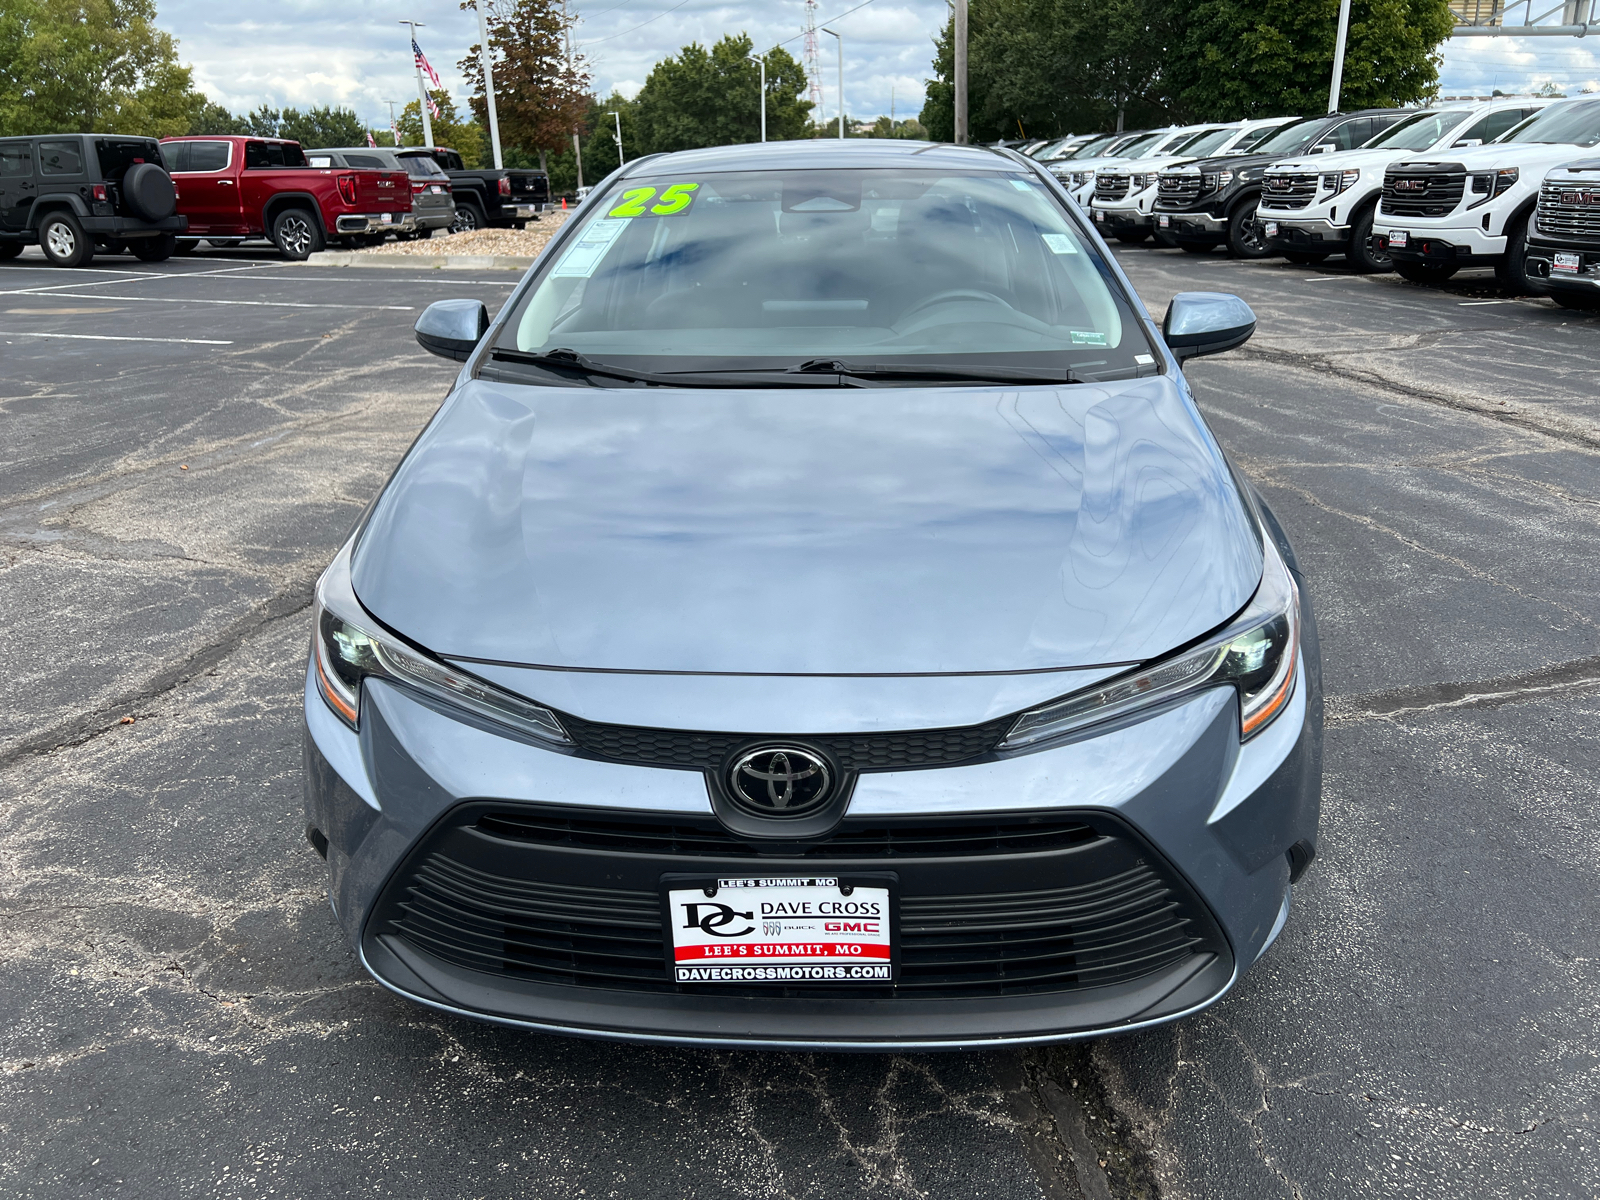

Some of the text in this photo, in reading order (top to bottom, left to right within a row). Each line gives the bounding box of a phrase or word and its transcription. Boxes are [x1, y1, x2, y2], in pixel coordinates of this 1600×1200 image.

[1394, 180, 1425, 190] GMC
[608, 183, 699, 218] 25
[1562, 192, 1600, 204] GMC
[720, 880, 755, 888] LEE'S
[758, 879, 810, 887] SUMMIT
[760, 902, 881, 915] DAVE CROSS
[680, 902, 756, 938] DC
[824, 922, 880, 933] GMC
[704, 944, 862, 957] LEE'S SUMMIT, MO
[678, 966, 889, 980] DAVECROSSMOTORS.COM
